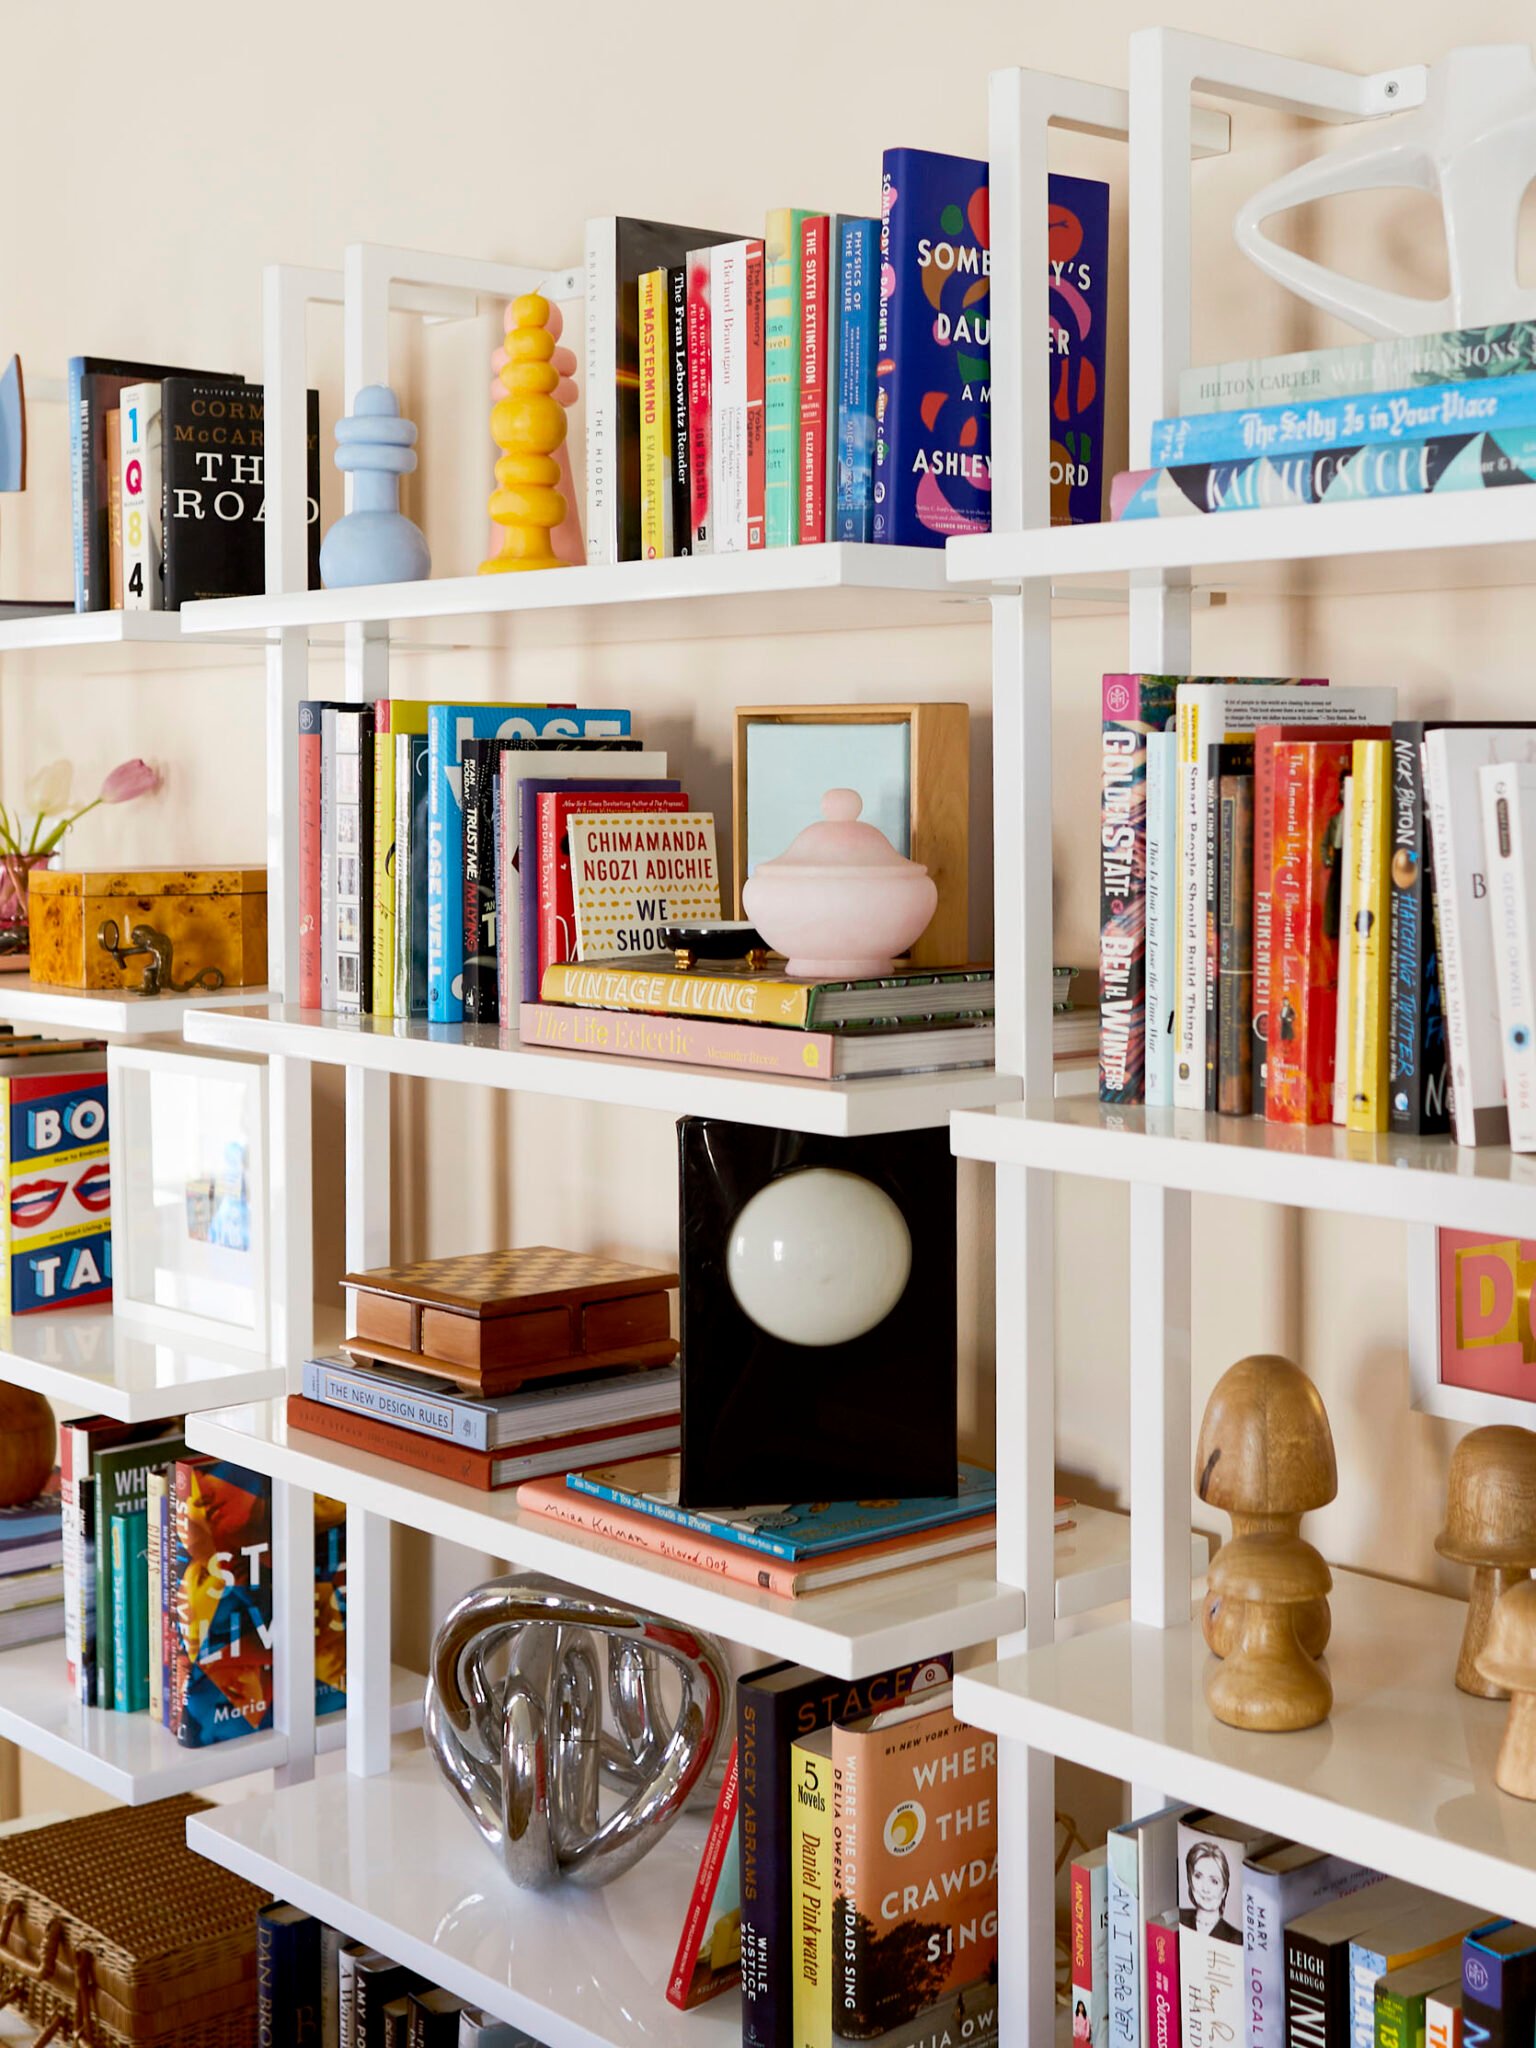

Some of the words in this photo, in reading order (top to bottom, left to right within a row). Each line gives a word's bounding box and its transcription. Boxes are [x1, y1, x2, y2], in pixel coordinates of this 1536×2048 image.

[805, 229, 817, 257] THE
[881, 172, 893, 271] SOMEBODY'S
[845, 232, 853, 259] THE
[853, 231, 862, 284] PHYSICS
[645, 283, 653, 305] THE
[674, 272, 685, 302] The
[723, 258, 735, 317] Richard
[753, 261, 761, 286] The
[805, 259, 817, 300] SIXTH
[845, 262, 853, 313] FUTURE
[699, 306, 706, 325] SO
[753, 290, 761, 347] Memory
[854, 289, 862, 312] OF
[878, 274, 889, 352] DAUGHTER
[675, 304, 687, 347] Fran
[690, 302, 698, 353] PUBLICLY
[805, 303, 817, 384] EXTINCTION
[642, 307, 656, 425] MASTERMIND
[722, 319, 735, 386] Brautigan
[675, 350, 688, 428] Lebowitz
[691, 358, 699, 405] SHAMED
[961, 383, 973, 401] A
[1199, 377, 1255, 400] HILTON
[1259, 368, 1321, 393] CARTER
[128, 407, 139, 444] 1
[596, 409, 604, 438] THE
[754, 408, 762, 442] Yoko
[1239, 411, 1277, 450] The
[1279, 407, 1337, 444] Selby
[1342, 403, 1365, 437] Is
[1368, 405, 1389, 429] in
[1389, 394, 1441, 437] Your
[1440, 389, 1499, 426] Place
[125, 458, 143, 496] Q
[646, 434, 656, 474] EVAN
[676, 431, 688, 485] Reader
[805, 430, 814, 483] ELIZABETH
[912, 448, 992, 481] ASHLEY
[595, 448, 604, 508] HIDDEN
[127, 510, 142, 548] 8
[646, 479, 656, 536] RATLIFF
[805, 485, 814, 527] KOLBERT
[128, 561, 144, 598] 4
[463, 758, 471, 800] HOLIDAY
[468, 758, 477, 786] RYAN
[1101, 731, 1137, 826] GOLDEN
[1289, 752, 1304, 776] The
[1395, 739, 1415, 786] NICK
[1188, 766, 1199, 816] Smart
[1206, 778, 1215, 808] WHAT
[1288, 781, 1301, 836] Immortal
[466, 807, 478, 849] TRUST
[541, 800, 550, 864] WEDDING
[1206, 810, 1214, 838] KIND
[1395, 785, 1415, 847] BILTON
[429, 820, 442, 896] LOSE
[587, 831, 708, 853] CHIMAMANDA
[1101, 825, 1136, 898] STATE
[1184, 822, 1197, 878] People
[1206, 841, 1214, 854] OF
[1286, 842, 1299, 867] Life
[541, 866, 550, 900] DATE
[584, 859, 638, 881] NGOZI
[646, 857, 713, 880] ADICHIE
[1206, 858, 1214, 901] WOMAN
[1285, 873, 1299, 888] of
[465, 905, 479, 953] LYING
[636, 898, 668, 922] WE
[1186, 881, 1198, 940] Should
[1283, 893, 1299, 950] Henrietta
[429, 904, 442, 983] WELL
[616, 928, 668, 952] SHOU
[1101, 935, 1130, 983] BEN
[1399, 892, 1418, 985] HATCHING
[1502, 871, 1514, 939] GEORGE
[1508, 946, 1521, 1008] ORWELL
[1186, 945, 1197, 988] Build
[1282, 954, 1297, 992] Lacks
[563, 970, 665, 1007] VINTAGE
[667, 977, 758, 1014] LIVING
[1104, 985, 1125, 999] H.
[534, 1009, 569, 1041] The
[573, 1015, 609, 1045] Life
[615, 1019, 695, 1055] Eclectic
[1100, 1000, 1130, 1091] WINTERS
[1183, 995, 1196, 1054] Things.
[1397, 992, 1417, 1079] TWITTER
[1518, 1071, 1528, 1108] 1984
[328, 1382, 348, 1400] THE
[352, 1388, 376, 1406] NEW
[379, 1396, 416, 1419] DESIGN
[418, 1408, 450, 1430] RULES
[619, 1491, 631, 1508] You
[147, 1522, 160, 1576] GIANTS
[544, 1502, 585, 1528] Maira
[591, 1515, 650, 1547] Kalman
[659, 1540, 702, 1566] Beloved
[174, 1580, 191, 1656] LIVES
[213, 1698, 267, 1725] Maria
[743, 1704, 757, 1797] STACEY
[899, 1739, 922, 1752] NEW
[925, 1729, 950, 1743] YORK
[803, 1760, 819, 1792] 5
[844, 1755, 857, 1817] WHERE
[912, 1741, 997, 1793] WHER
[797, 1784, 826, 1813] Novels
[833, 1768, 843, 1819] DELIA
[844, 1823, 857, 1857] THE
[936, 1799, 991, 1842] THE
[744, 1801, 757, 1901] ABRAMS
[801, 1831, 821, 1890] Daniel
[833, 1826, 843, 1891] OWENS
[844, 1862, 857, 1960] CRAWDADS
[1074, 1882, 1085, 1920] MINDY
[1246, 1893, 1256, 1952] KUBICA
[801, 1892, 822, 1986] Pinkwater
[926, 1911, 998, 1963] SING
[1074, 1922, 1085, 1968] KALING
[1257, 1906, 1268, 1952] MARY
[257, 1926, 273, 1988] DAN
[746, 1921, 757, 2001] JUSTICE
[757, 1936, 768, 1993] WHILE
[1288, 1947, 1326, 1978] LEIGH
[1288, 1968, 1326, 1992] BARDUGO
[844, 1965, 857, 2009] SING
[1251, 1967, 1264, 2034] LOCAL
